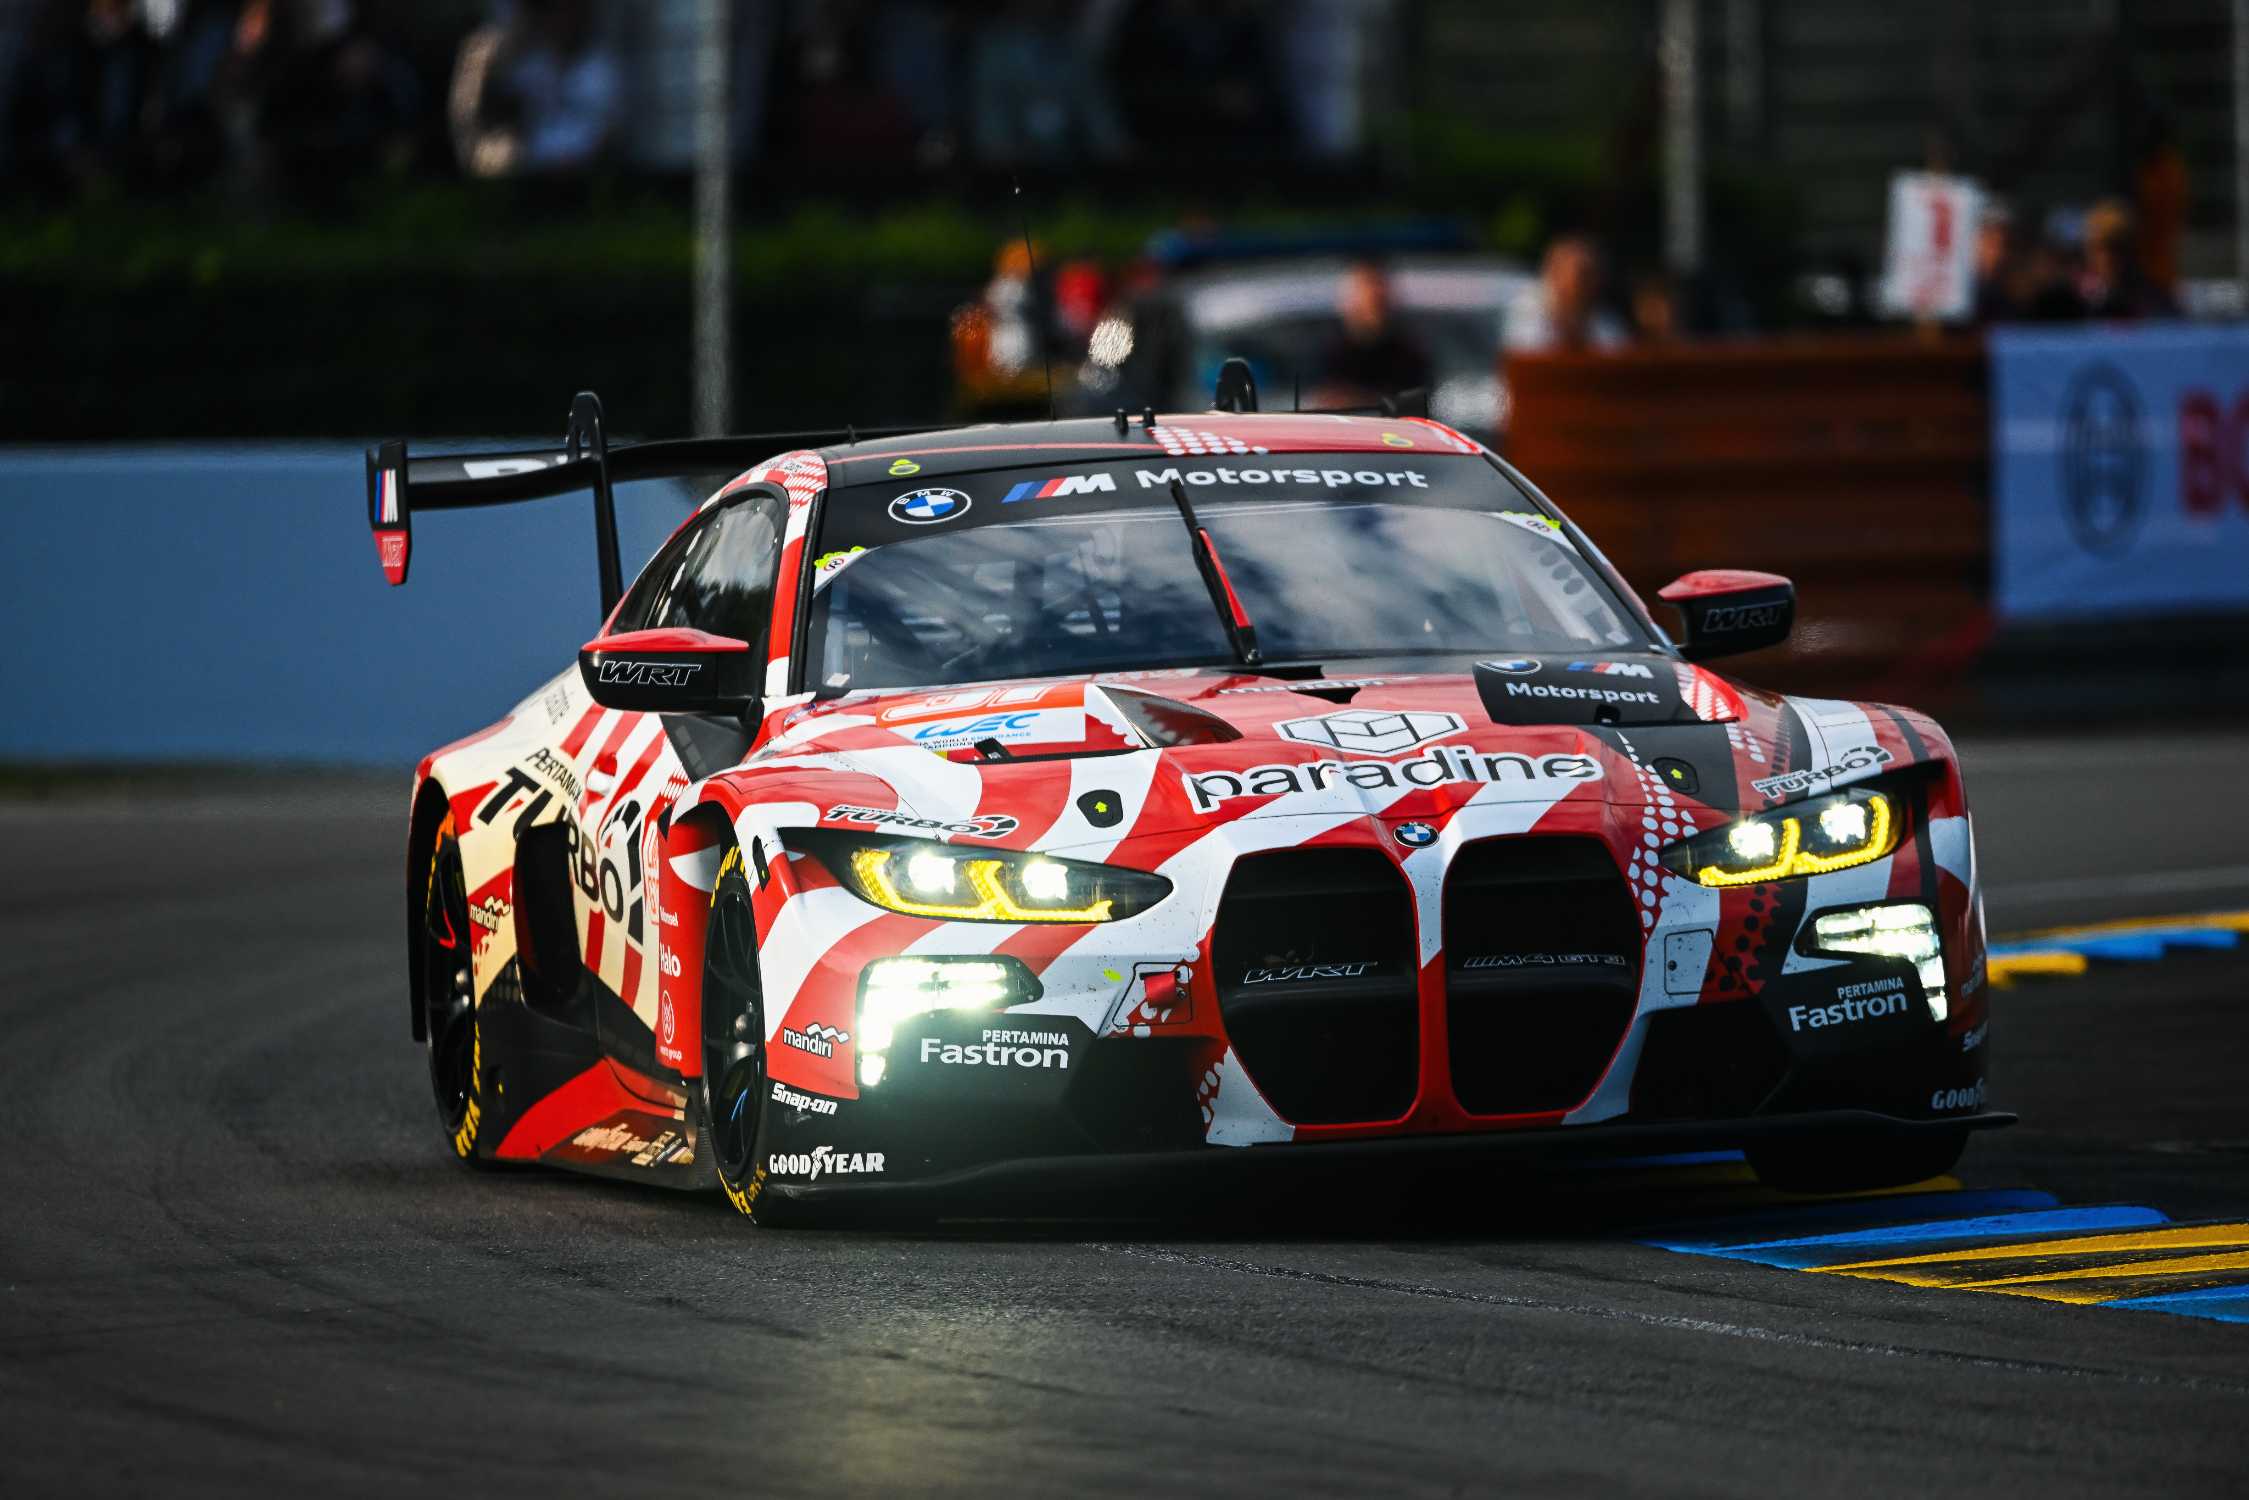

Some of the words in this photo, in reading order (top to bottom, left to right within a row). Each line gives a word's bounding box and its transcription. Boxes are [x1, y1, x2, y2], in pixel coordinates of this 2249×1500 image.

[1134, 466, 1429, 490] Motorsport
[599, 660, 702, 687] WRT
[1505, 682, 1660, 704] Motorsport
[914, 713, 1040, 740] WEC
[1191, 749, 1597, 809] paradine
[1759, 757, 1872, 797] TURBO
[828, 809, 981, 834] TURBO
[1243, 961, 1378, 984] WRT
[1837, 976, 1905, 999] PERTAMINA
[1788, 990, 1908, 1032] Fastron
[783, 1026, 833, 1058] mandiri
[982, 1029, 1070, 1046] PERTAMINA
[920, 1038, 1069, 1069] Fastron
[771, 1082, 838, 1115] Snap-on
[769, 1145, 885, 1181] GOODYEAR
